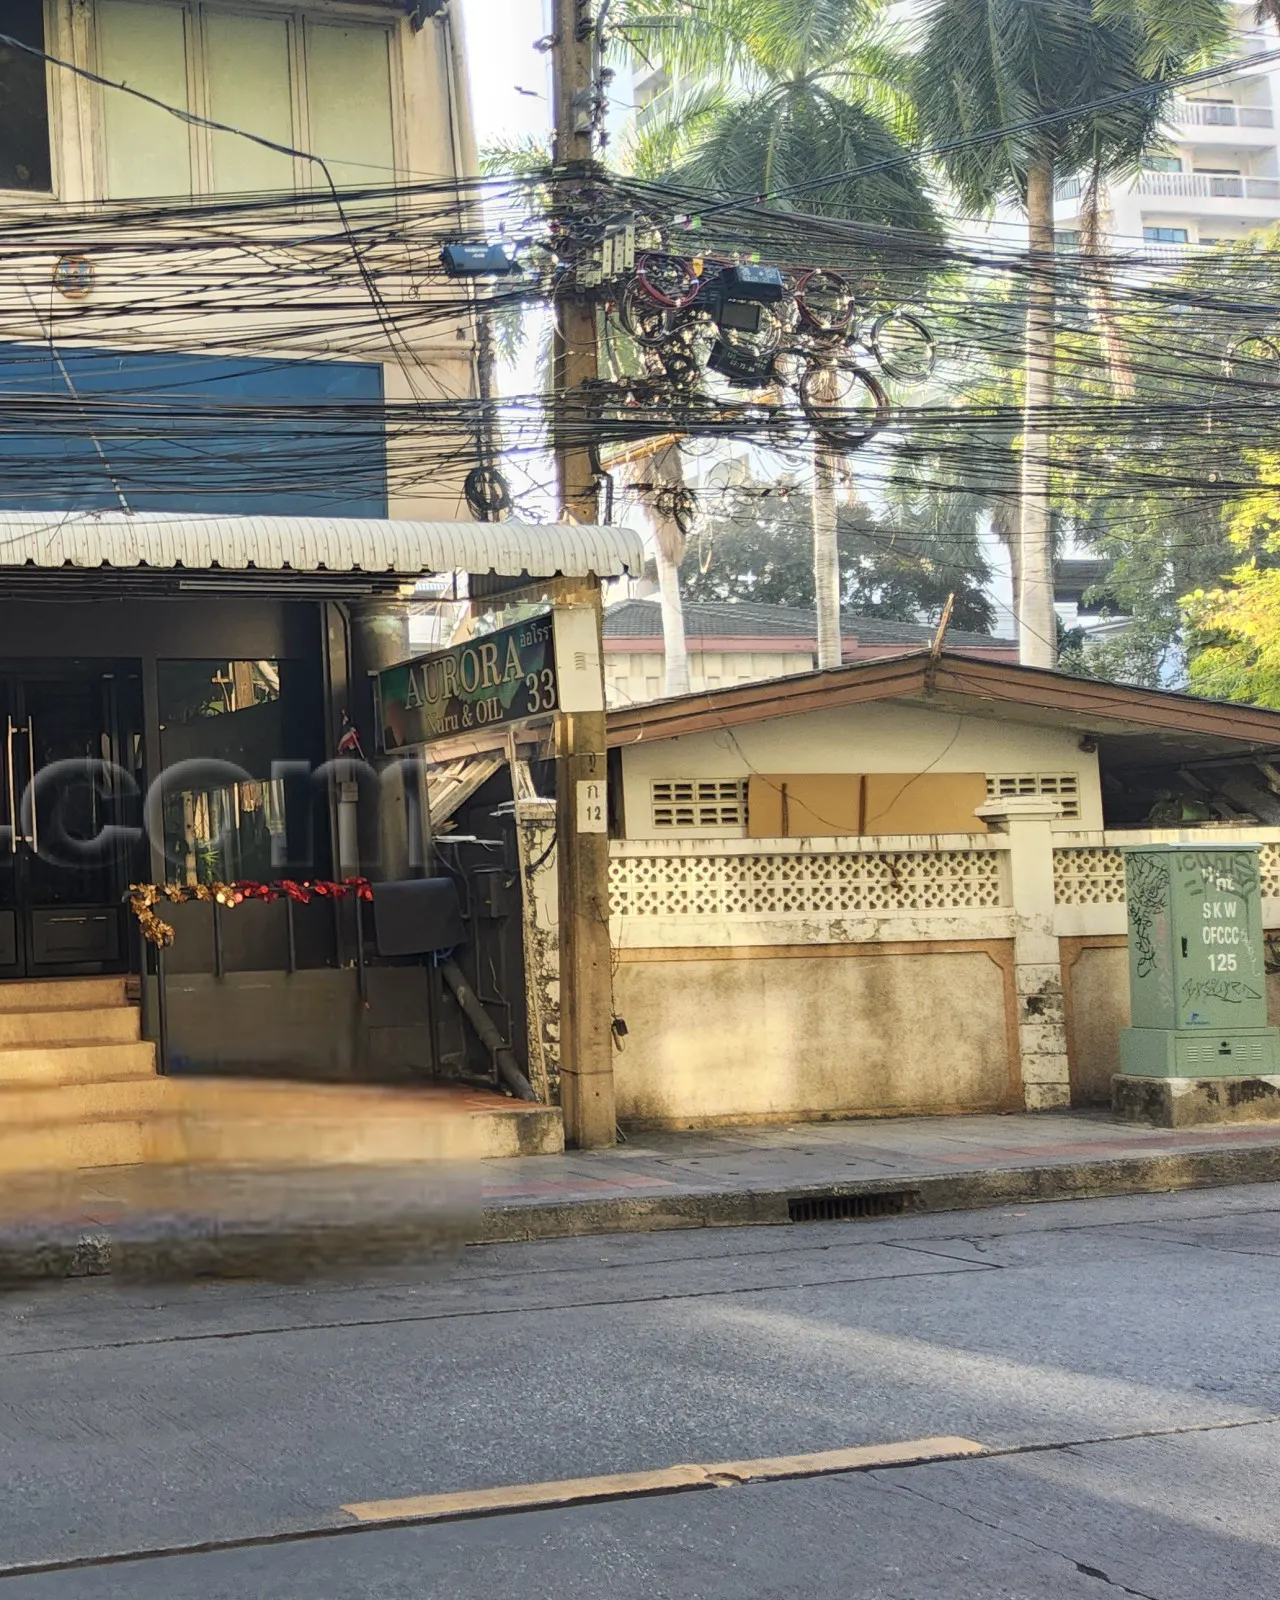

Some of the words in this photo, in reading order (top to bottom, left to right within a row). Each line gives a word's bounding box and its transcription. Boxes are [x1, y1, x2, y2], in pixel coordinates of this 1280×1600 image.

[520, 623, 552, 647] ออโรร
[405, 636, 524, 710] AURORA
[526, 668, 556, 713] 33
[428, 714, 459, 737] Nuru
[462, 703, 473, 727] &
[476, 697, 503, 724] OIL
[586, 805, 601, 820] 12
[1202, 926, 1240, 944] OFCCC
[1207, 953, 1237, 971] 125
